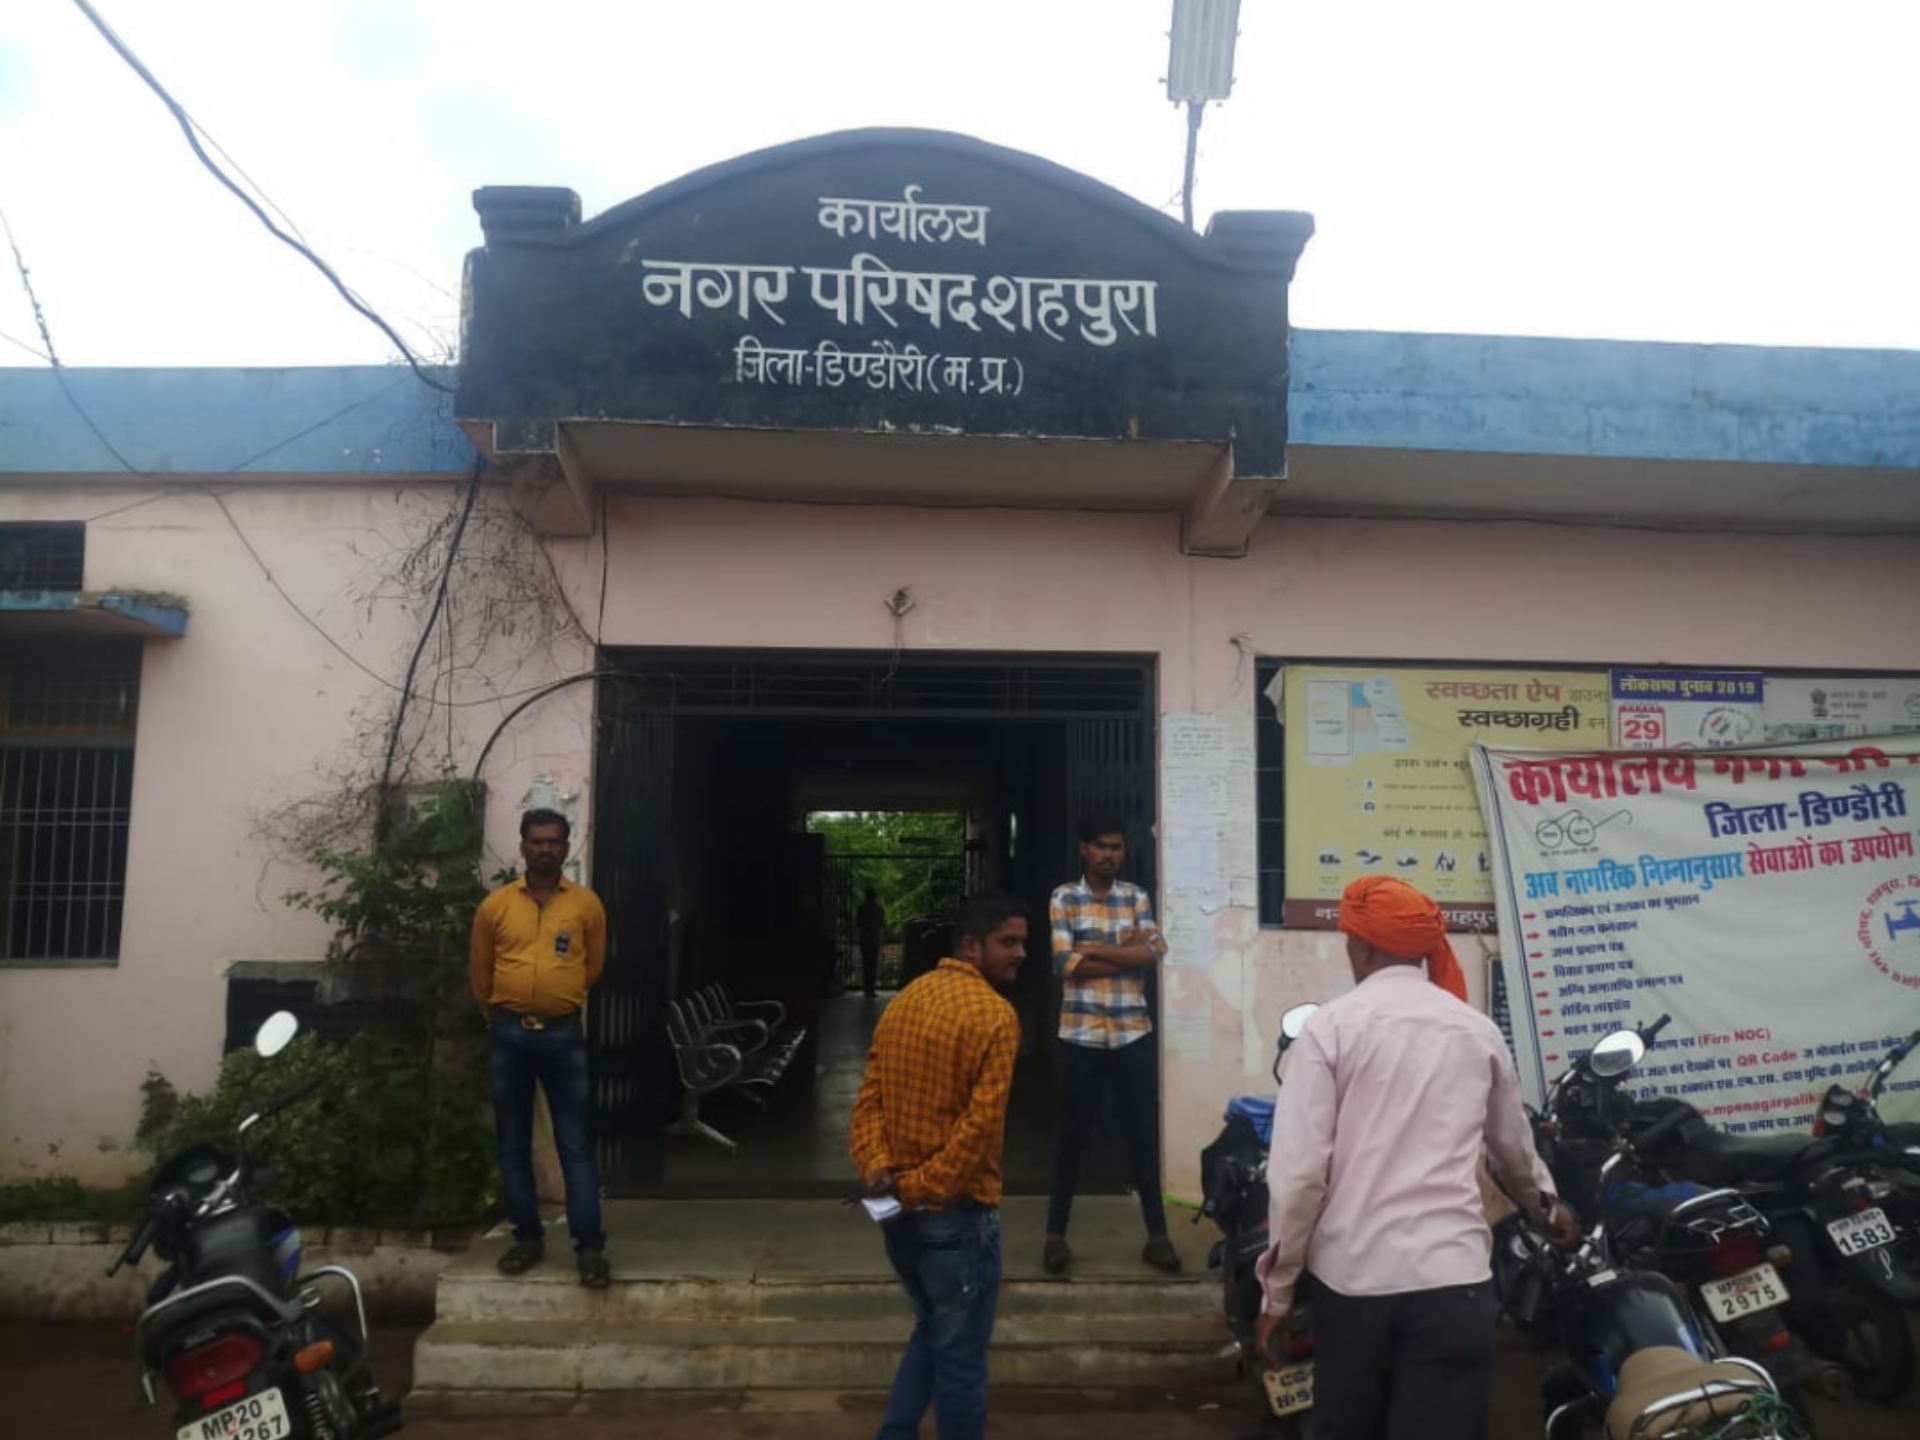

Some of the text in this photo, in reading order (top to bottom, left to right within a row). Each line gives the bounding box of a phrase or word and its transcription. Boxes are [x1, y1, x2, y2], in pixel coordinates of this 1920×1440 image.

[819, 185, 990, 246] कार्यालय
[642, 259, 795, 326] नगर
[1425, 682, 1518, 701] स्वच्छता
[1525, 678, 1563, 701] ऐप
[1717, 681, 1755, 695] 2019
[1457, 705, 1579, 732] स्वच्छाग्रही
[1624, 719, 1661, 740] 29
[1524, 871, 1559, 898] अब
[1563, 859, 1636, 894] नागरिक
[1747, 835, 1814, 875] सेवाओं
[1816, 840, 1845, 867] का
[1848, 827, 1914, 864] उपयोग
[1734, 1028, 1771, 1043] NOC)
[1737, 1054, 1757, 1067] QR
[1762, 1050, 1797, 1065] Code
[1839, 1223, 1891, 1253] 1583
[1722, 1284, 1777, 1316] 2975
[201, 1399, 262, 1440] MP20
